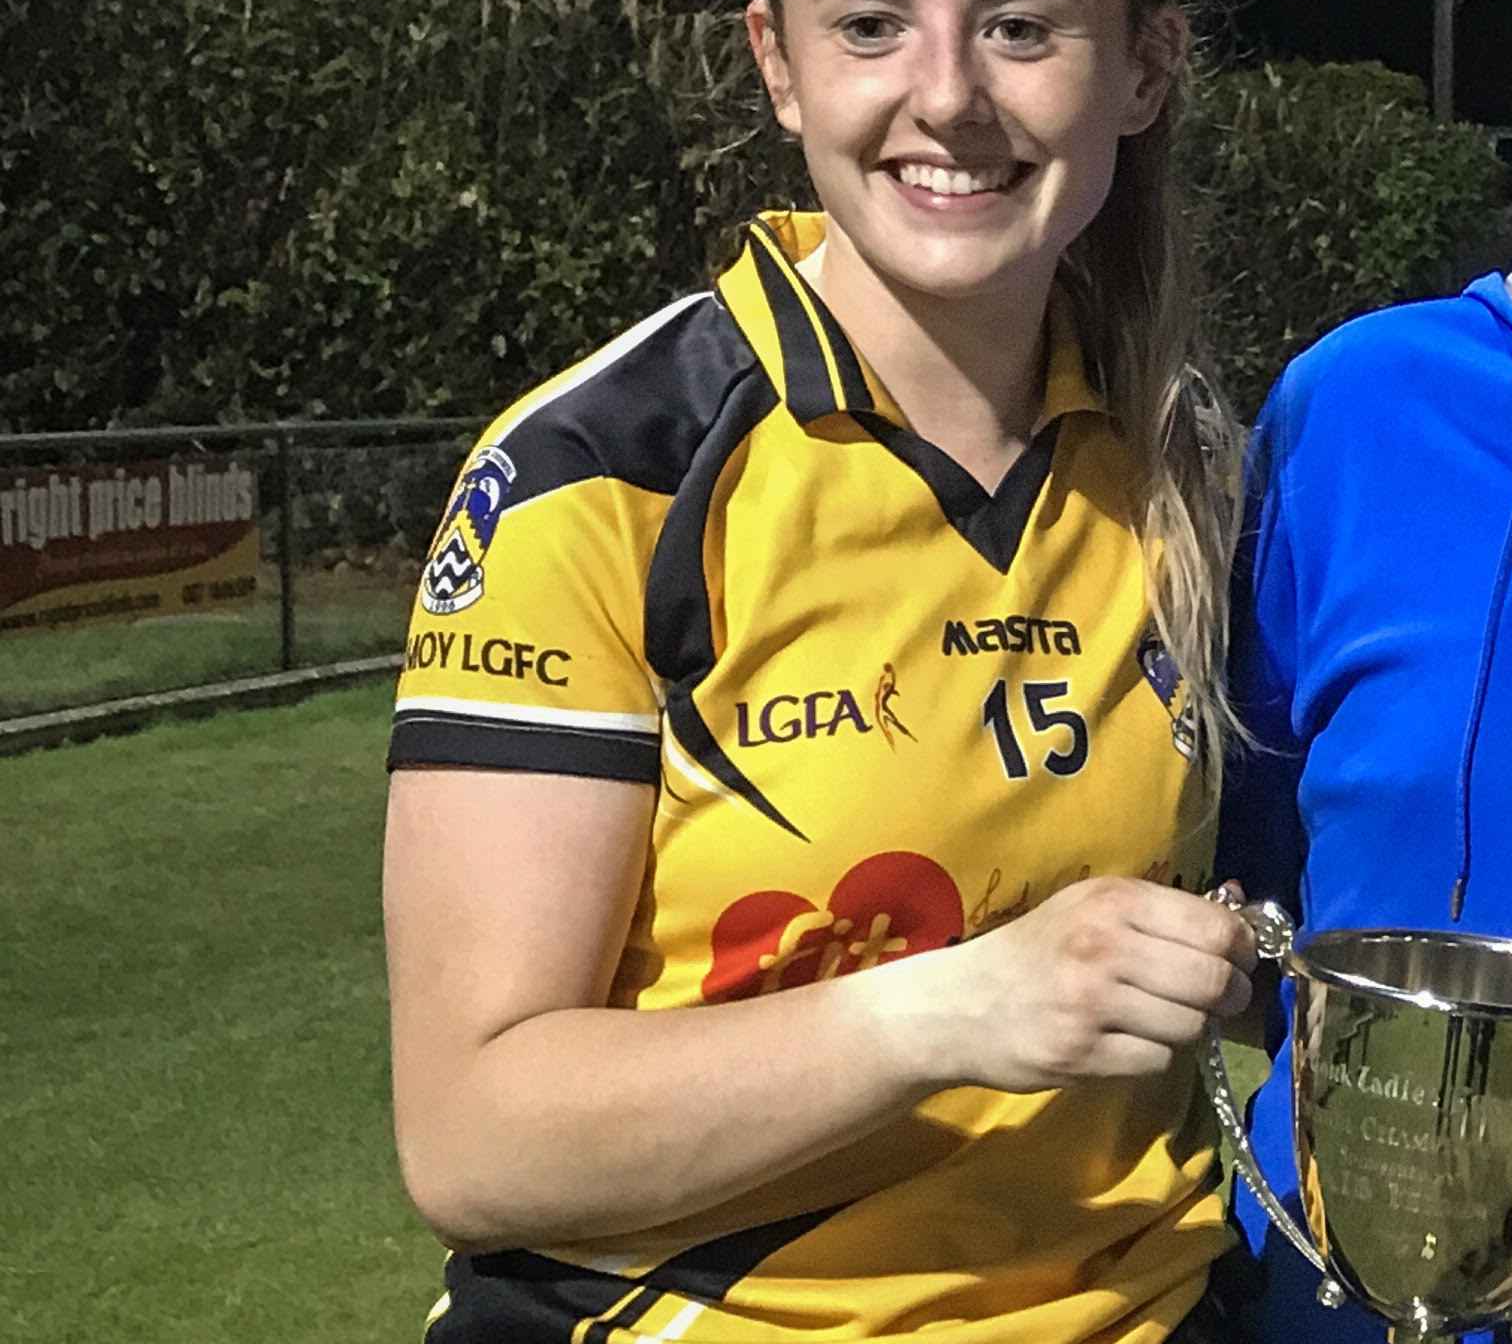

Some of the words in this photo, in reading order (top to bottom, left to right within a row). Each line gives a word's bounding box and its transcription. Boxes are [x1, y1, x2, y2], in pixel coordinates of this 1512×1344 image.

[461, 633, 573, 688] LGFC
[735, 689, 874, 748] LGFA
[982, 678, 1090, 780] 15
